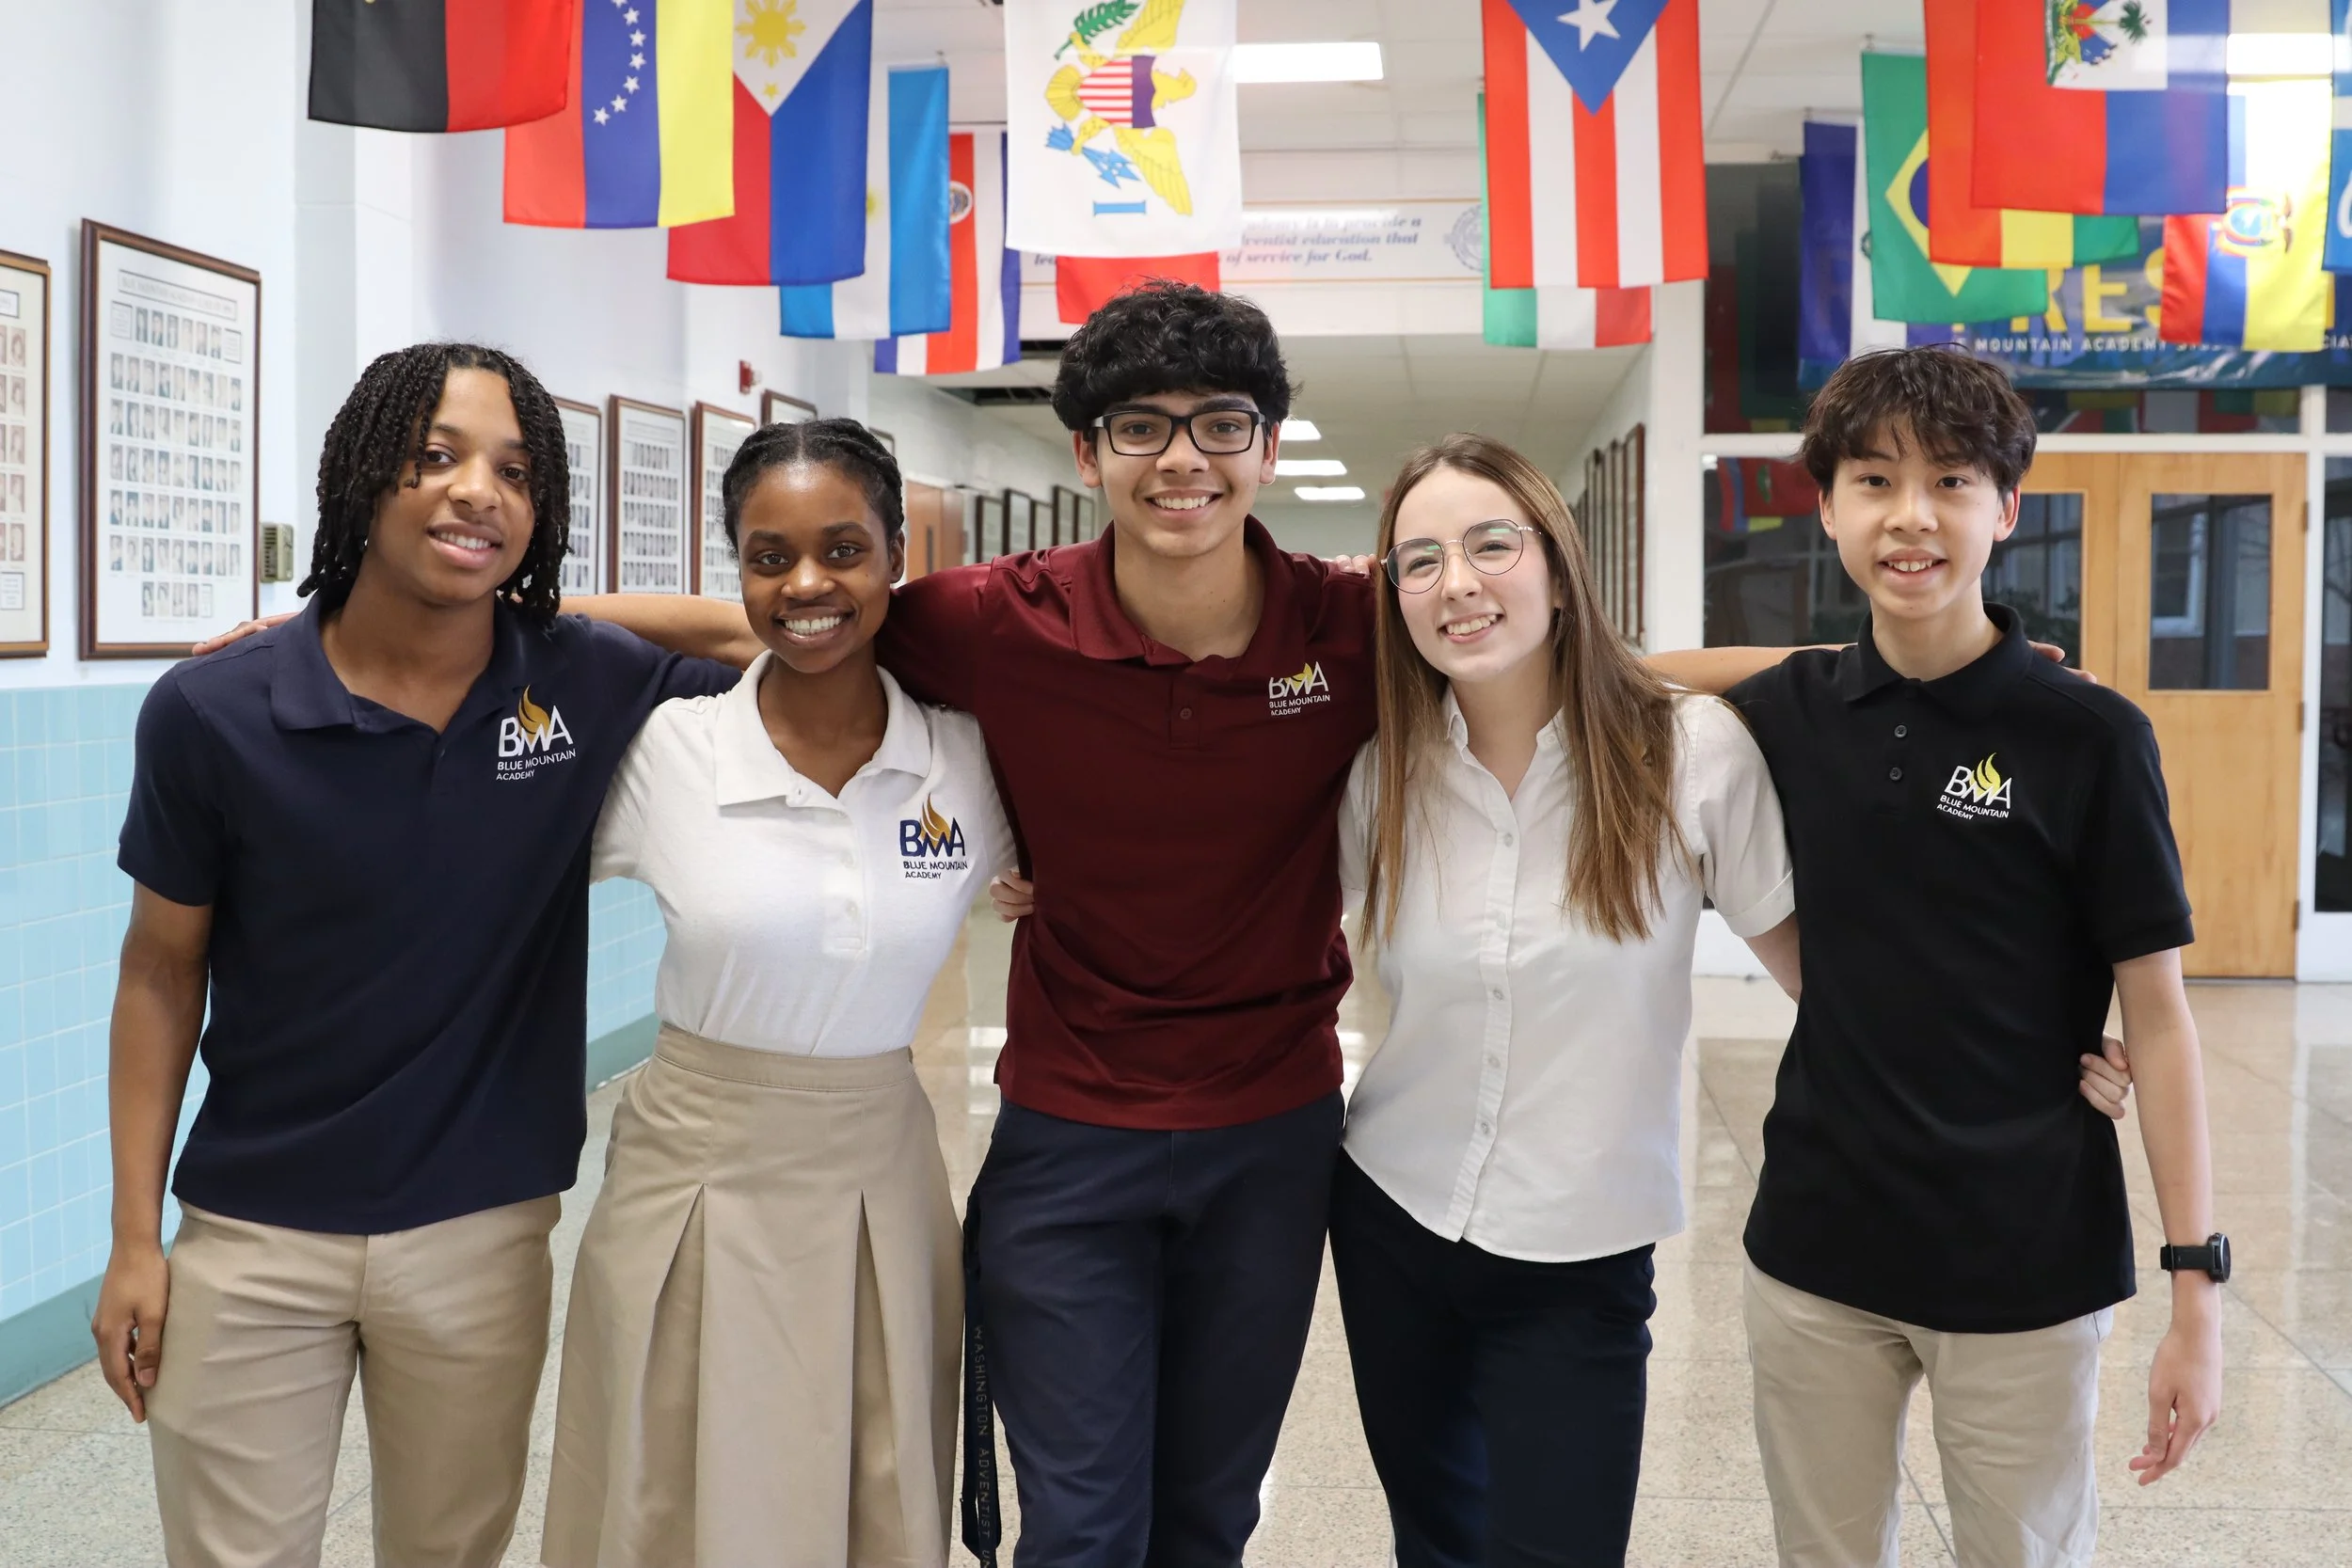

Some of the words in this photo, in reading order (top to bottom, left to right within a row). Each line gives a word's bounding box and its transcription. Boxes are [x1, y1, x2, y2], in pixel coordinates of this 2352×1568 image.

[1974, 336, 2073, 353] MOUNTAIN
[1269, 700, 1288, 708] BLUE
[1288, 694, 1330, 707] MOUNTAIN
[1270, 706, 1301, 717] ACADEMY
[498, 705, 574, 757] BMA
[497, 760, 523, 770] BLUE
[525, 748, 577, 769] MOUNTAIN
[496, 769, 535, 781] ACADEMY
[1944, 765, 2012, 810] BMA
[1936, 803, 1974, 820] ACADEMY
[1939, 794, 1963, 809] BLUE
[1963, 803, 2010, 818] MOUNTAIN
[899, 816, 965, 858] BMA
[903, 861, 928, 870] BLUE
[930, 861, 968, 871] MOUNTAIN
[905, 871, 942, 879] ACADEMY
[974, 1325, 988, 1436] WASHINGTON
[977, 1448, 990, 1538] ADVENTIST
